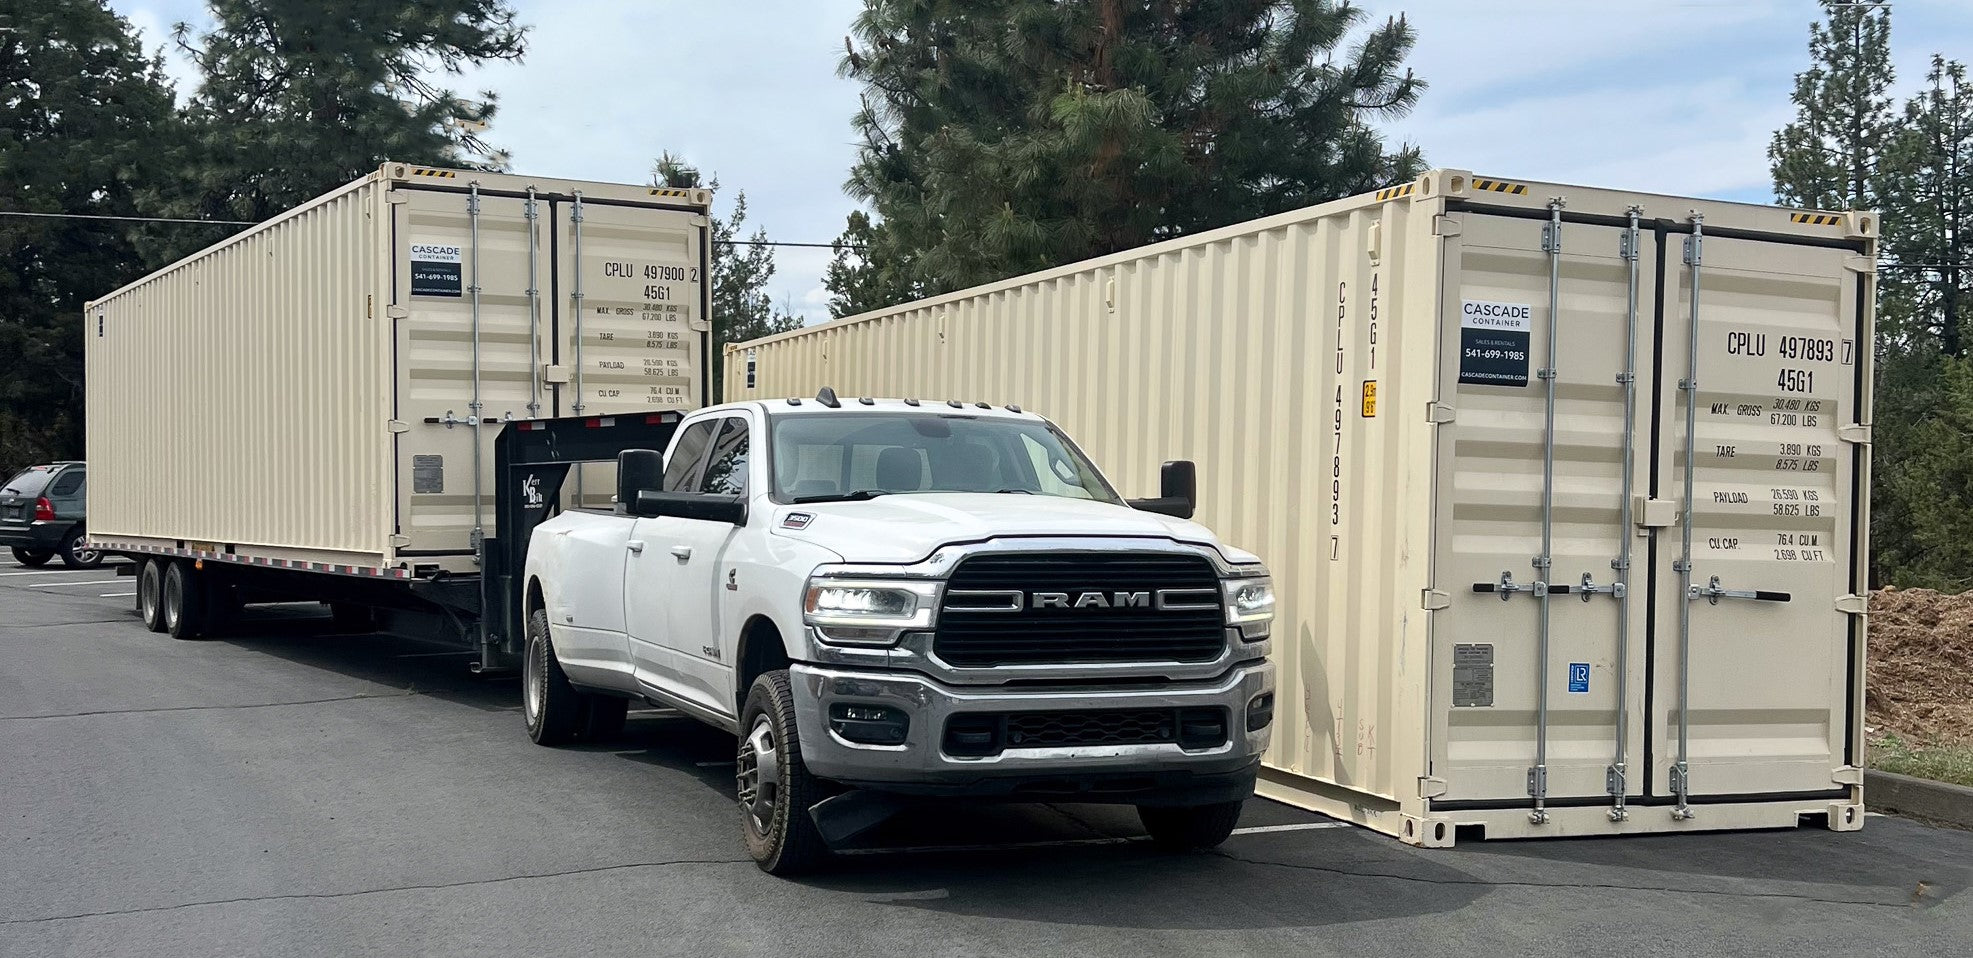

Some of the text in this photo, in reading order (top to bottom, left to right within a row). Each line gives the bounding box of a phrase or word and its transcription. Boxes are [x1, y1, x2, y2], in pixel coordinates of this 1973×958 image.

[411, 245, 460, 255] CASCADE
[414, 273, 459, 281] 541-699-1985
[605, 262, 698, 283] CPLU 497900 2
[643, 285, 670, 300] 45G1
[615, 307, 634, 316] GROSS
[666, 304, 678, 312] KGS
[1463, 303, 1530, 319] CASCADE
[665, 314, 677, 322] LBS
[1370, 272, 1378, 370] 45G1
[1472, 318, 1521, 327] CONTAINER
[599, 332, 614, 341] TARE
[667, 332, 679, 340] KGS
[666, 341, 678, 349] LBS
[1727, 331, 1852, 363] CPLU 497893 7
[1465, 348, 1525, 361] 541-699-1985
[599, 361, 625, 370] PAYLOAD
[667, 368, 679, 377] LBS
[1461, 371, 1527, 381] CASCADECONTAINER.COM
[1777, 368, 1813, 394] 45G1
[1710, 402, 1762, 417] MAX. GROSS
[1773, 398, 1821, 412] 30.480 KGS
[1331, 281, 1346, 560] CPLU 497893 7
[1770, 413, 1817, 427] 67.200 LBS
[1715, 445, 1736, 458] TARE
[1779, 443, 1821, 457] 3.890 KGS
[1775, 458, 1819, 471] 8.575 LBS
[1713, 491, 1748, 504] PAYLOAD
[1771, 488, 1819, 501] 26.590 KGS
[1773, 504, 1820, 517] 58.625 LBS
[1777, 533, 1793, 546] 76.4
[1774, 549, 1797, 561] 2.698
[1032, 591, 1150, 608] RAM
